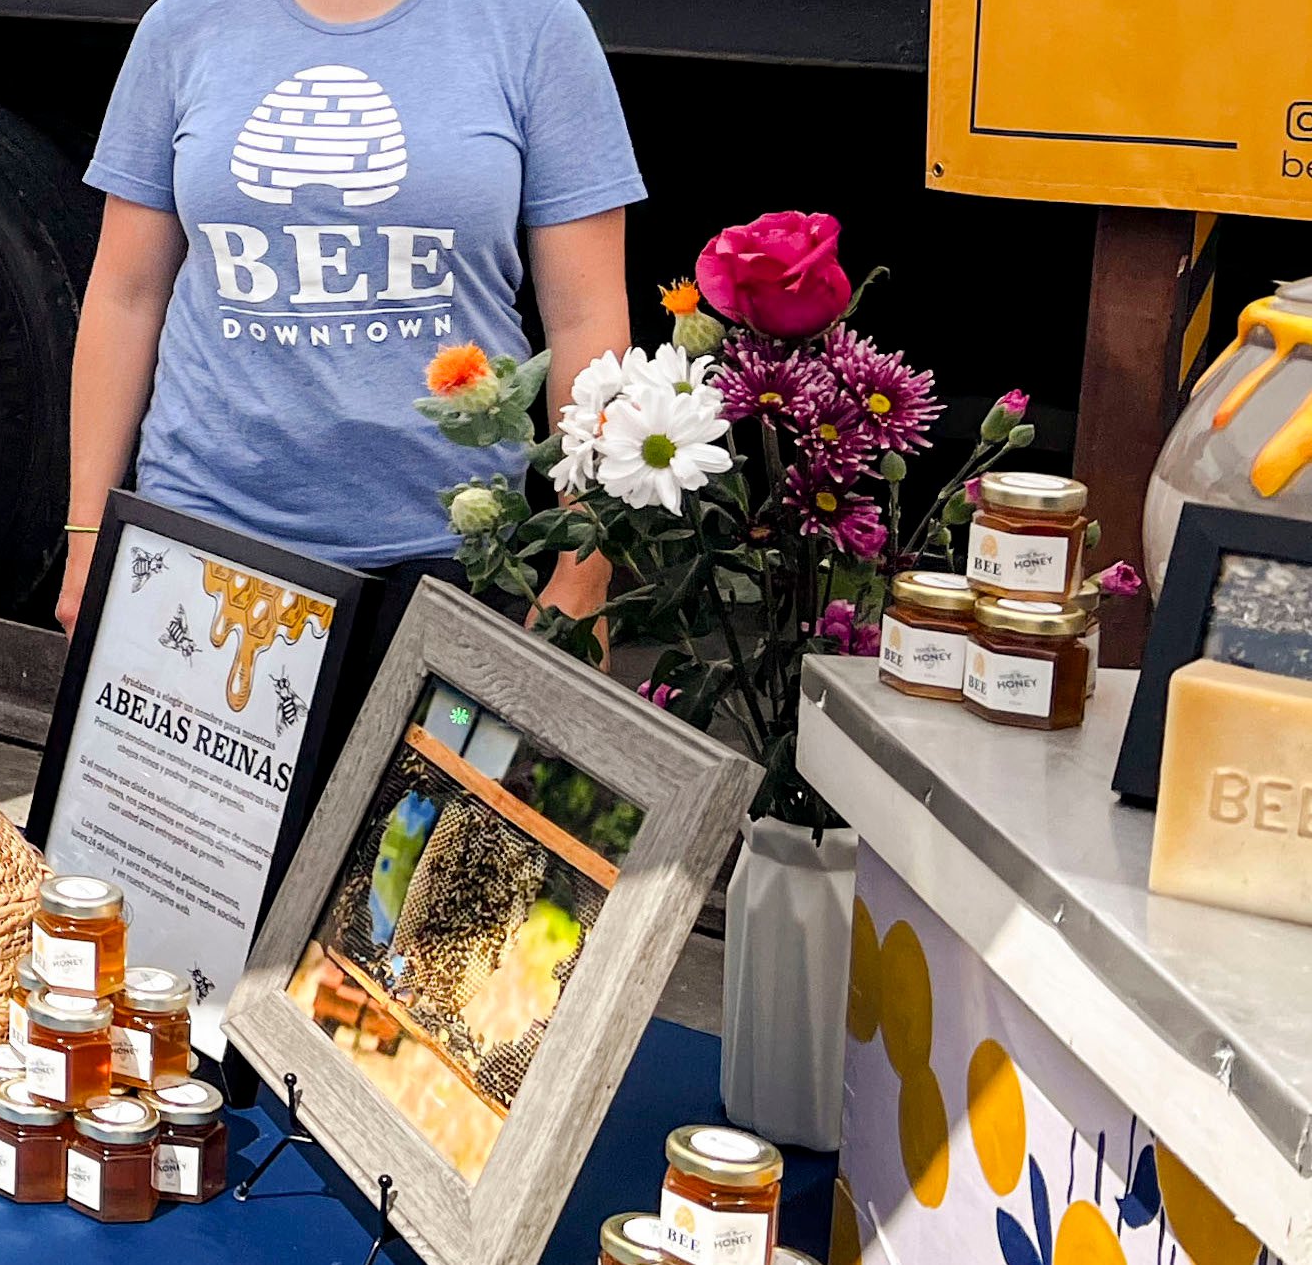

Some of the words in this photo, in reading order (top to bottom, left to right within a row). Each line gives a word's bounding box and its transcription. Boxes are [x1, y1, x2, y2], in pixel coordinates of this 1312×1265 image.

[198, 223, 455, 303] BEE
[222, 314, 452, 347] DOWNTOWN
[974, 557, 1002, 576] BEE
[1014, 556, 1053, 569] HONEY
[883, 647, 903, 667] BEE
[913, 652, 951, 662] HONEY
[968, 675, 987, 695] BEE
[997, 679, 1037, 689] HONEY
[96, 682, 191, 744] ABEJAS
[193, 724, 292, 792] REINAS
[52, 956, 83, 968] HONEY
[668, 1227, 700, 1254] BEE
[714, 1234, 753, 1249] HONEY
